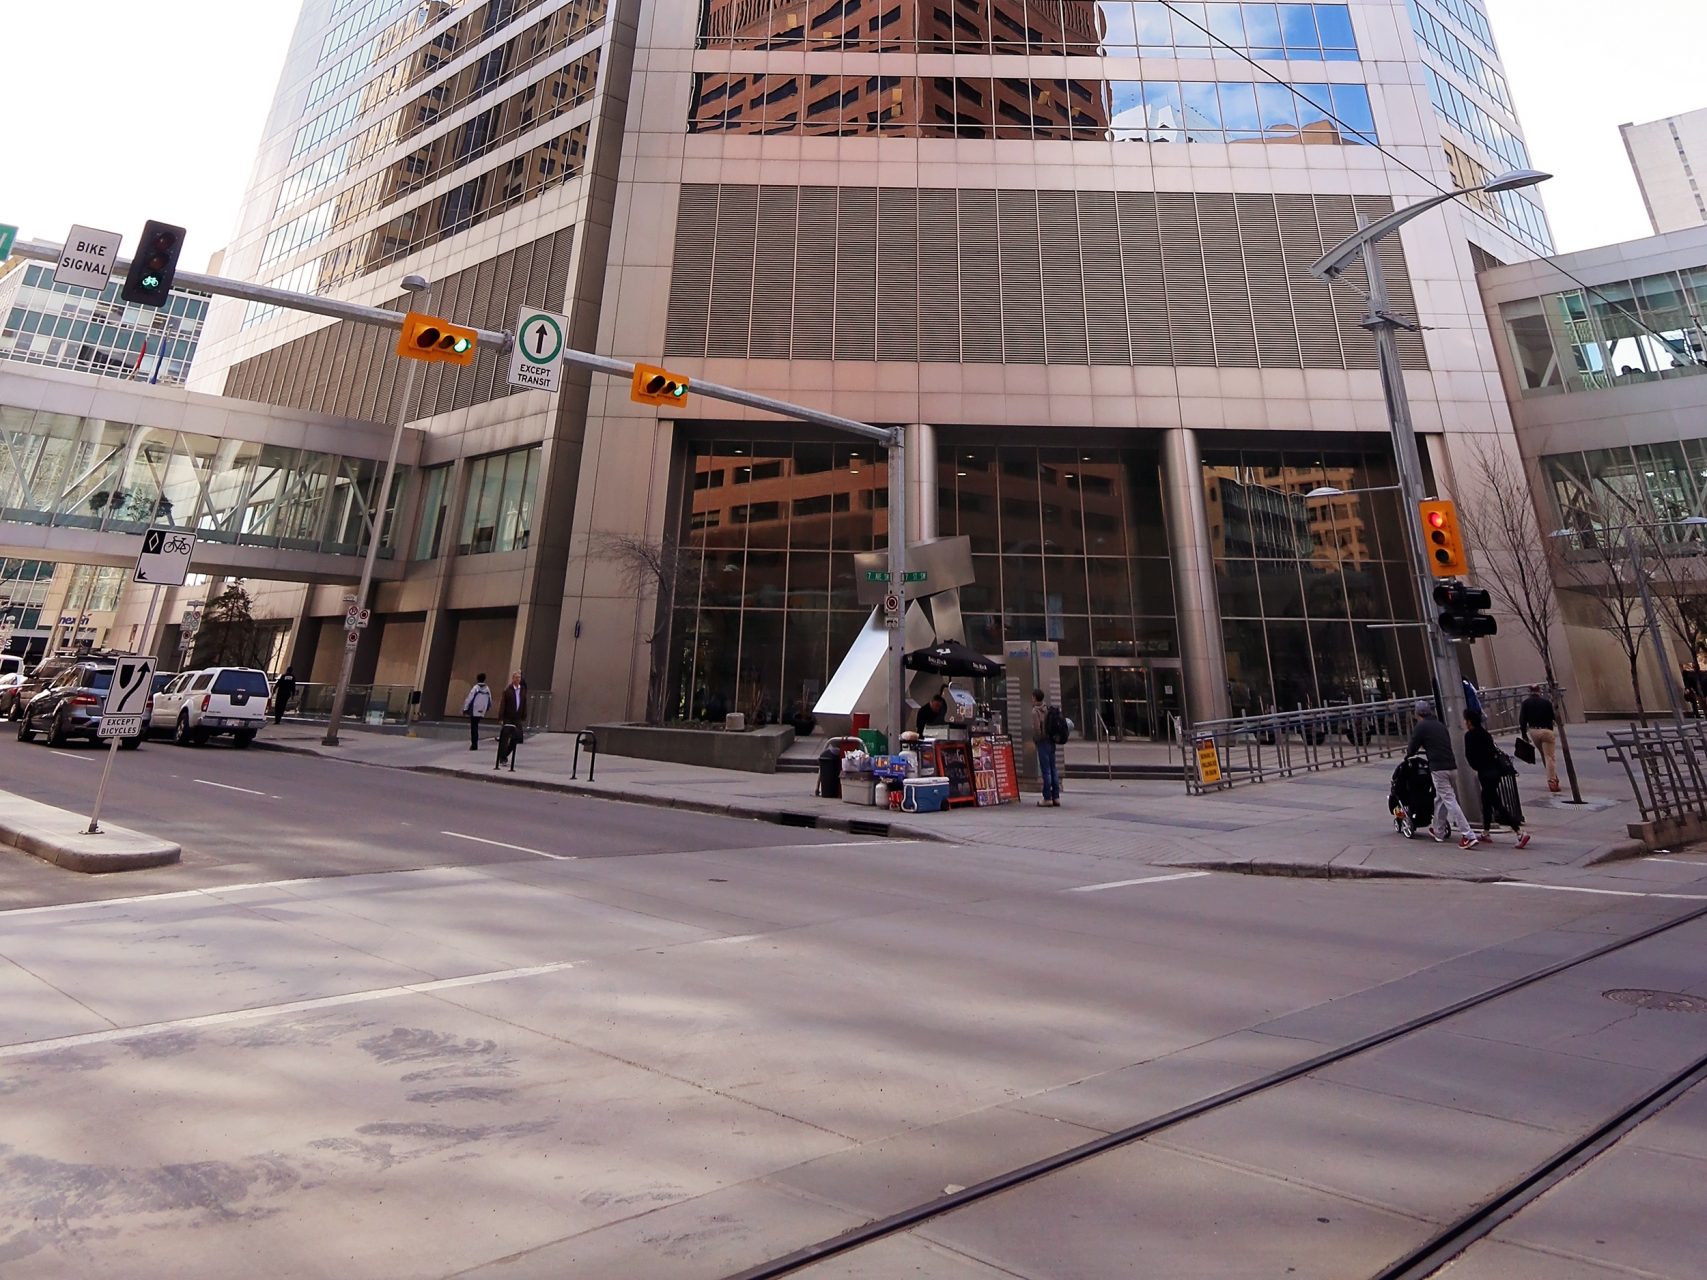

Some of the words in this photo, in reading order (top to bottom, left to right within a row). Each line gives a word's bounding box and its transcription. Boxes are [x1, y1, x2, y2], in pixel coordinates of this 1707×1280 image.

[76, 241, 107, 256] BIKE
[62, 257, 107, 275] SIGNAL
[520, 364, 551, 377] EXCEPT
[518, 373, 551, 387] TRANSIT
[60, 615, 89, 625] nexn
